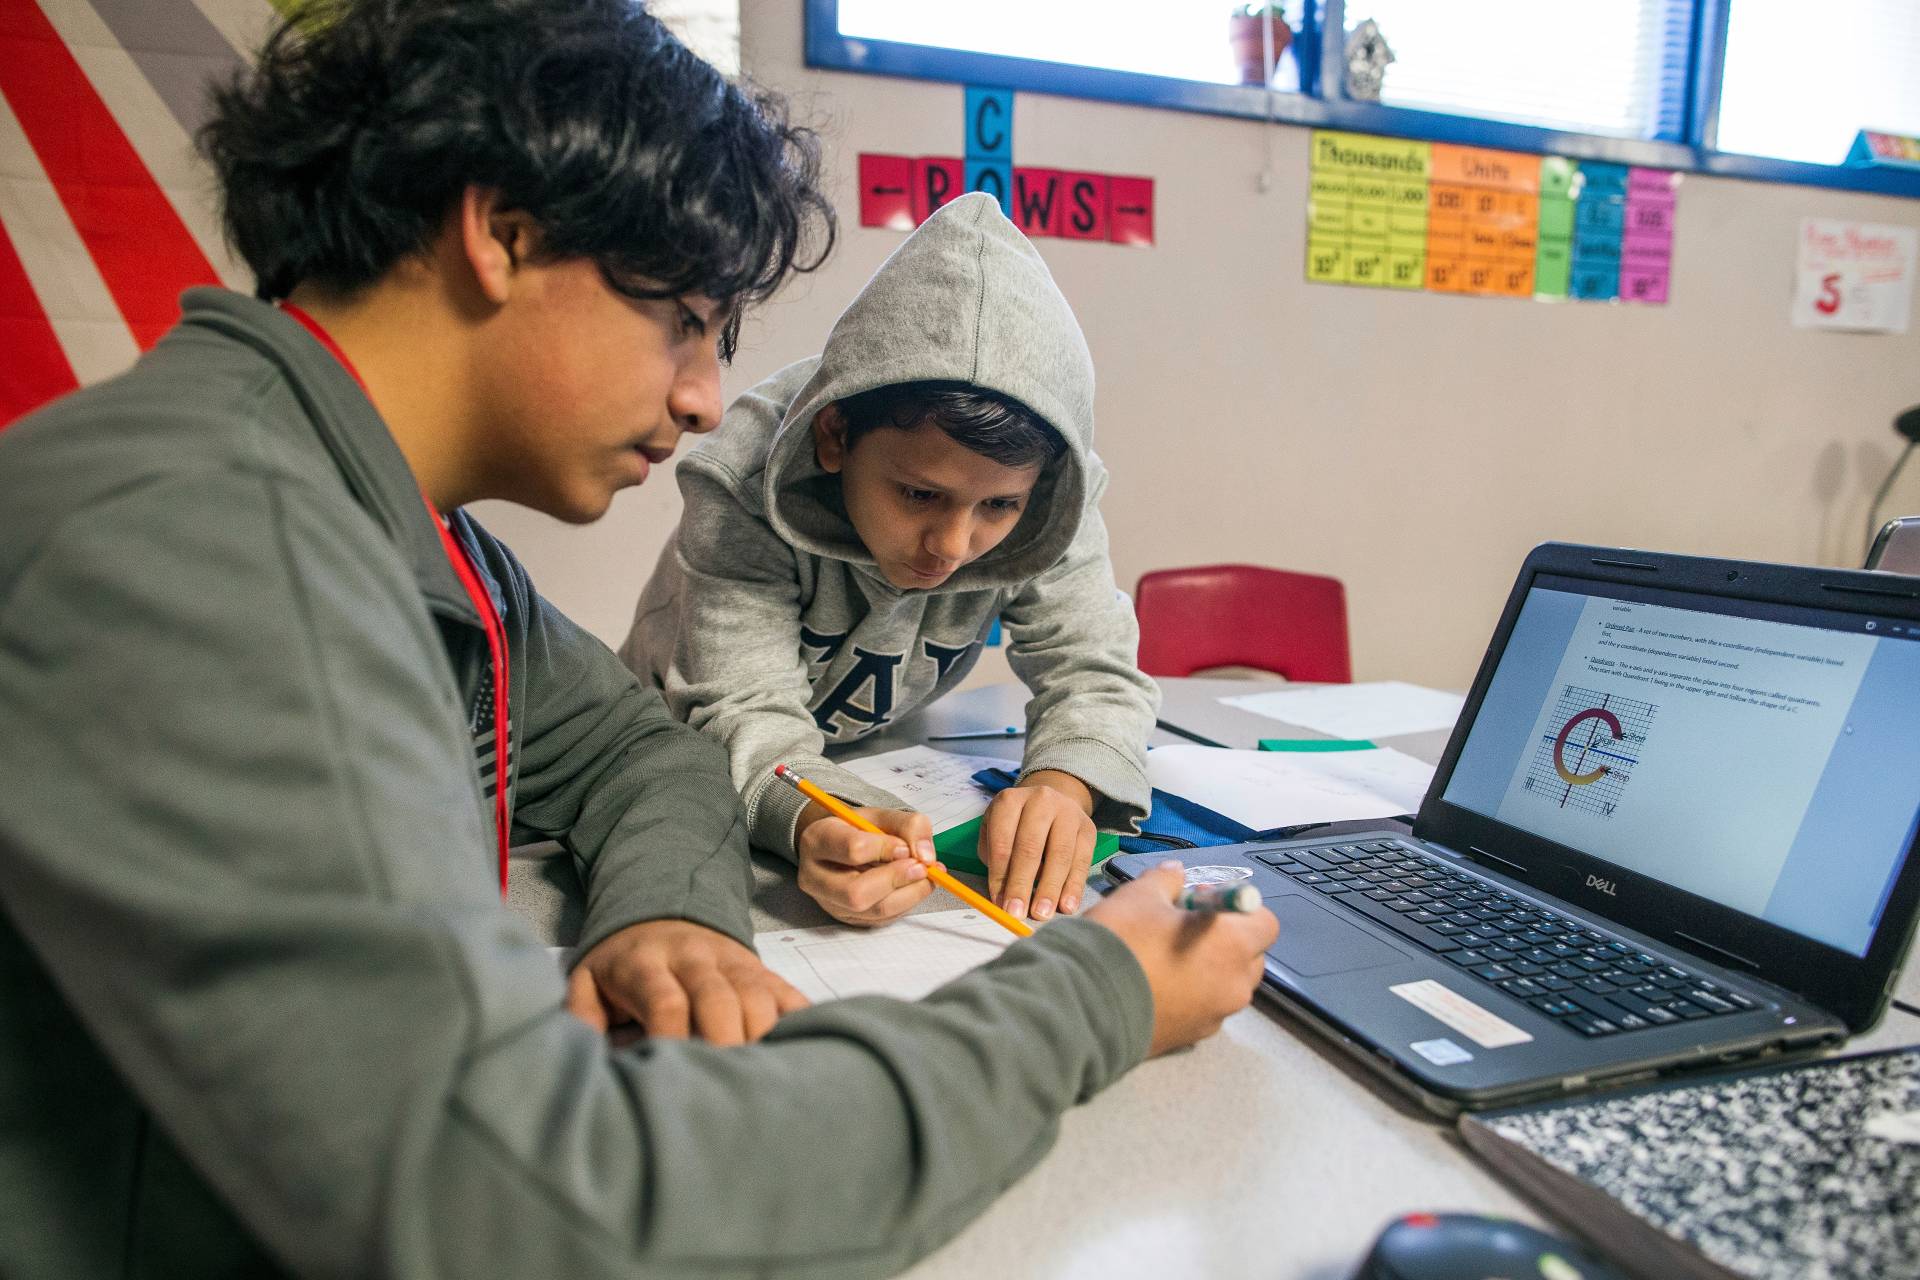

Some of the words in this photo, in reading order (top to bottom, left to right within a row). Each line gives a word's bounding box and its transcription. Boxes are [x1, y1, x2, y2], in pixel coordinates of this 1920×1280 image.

[1319, 139, 1423, 173] Thousands
[1462, 157, 1511, 180] Units
[1669, 633, 1694, 643] numbers,
[1587, 665, 1599, 673] They
[1685, 686, 1702, 695] upper
[1702, 688, 1717, 698] right
[1619, 661, 1629, 669] The
[1642, 667, 1654, 675] and
[1668, 671, 1692, 682] separate
[1692, 675, 1702, 683] the
[1719, 682, 1732, 690] into
[1731, 684, 1744, 692] four
[1612, 770, 1631, 784] Stop
[1585, 874, 1616, 896] DELL
